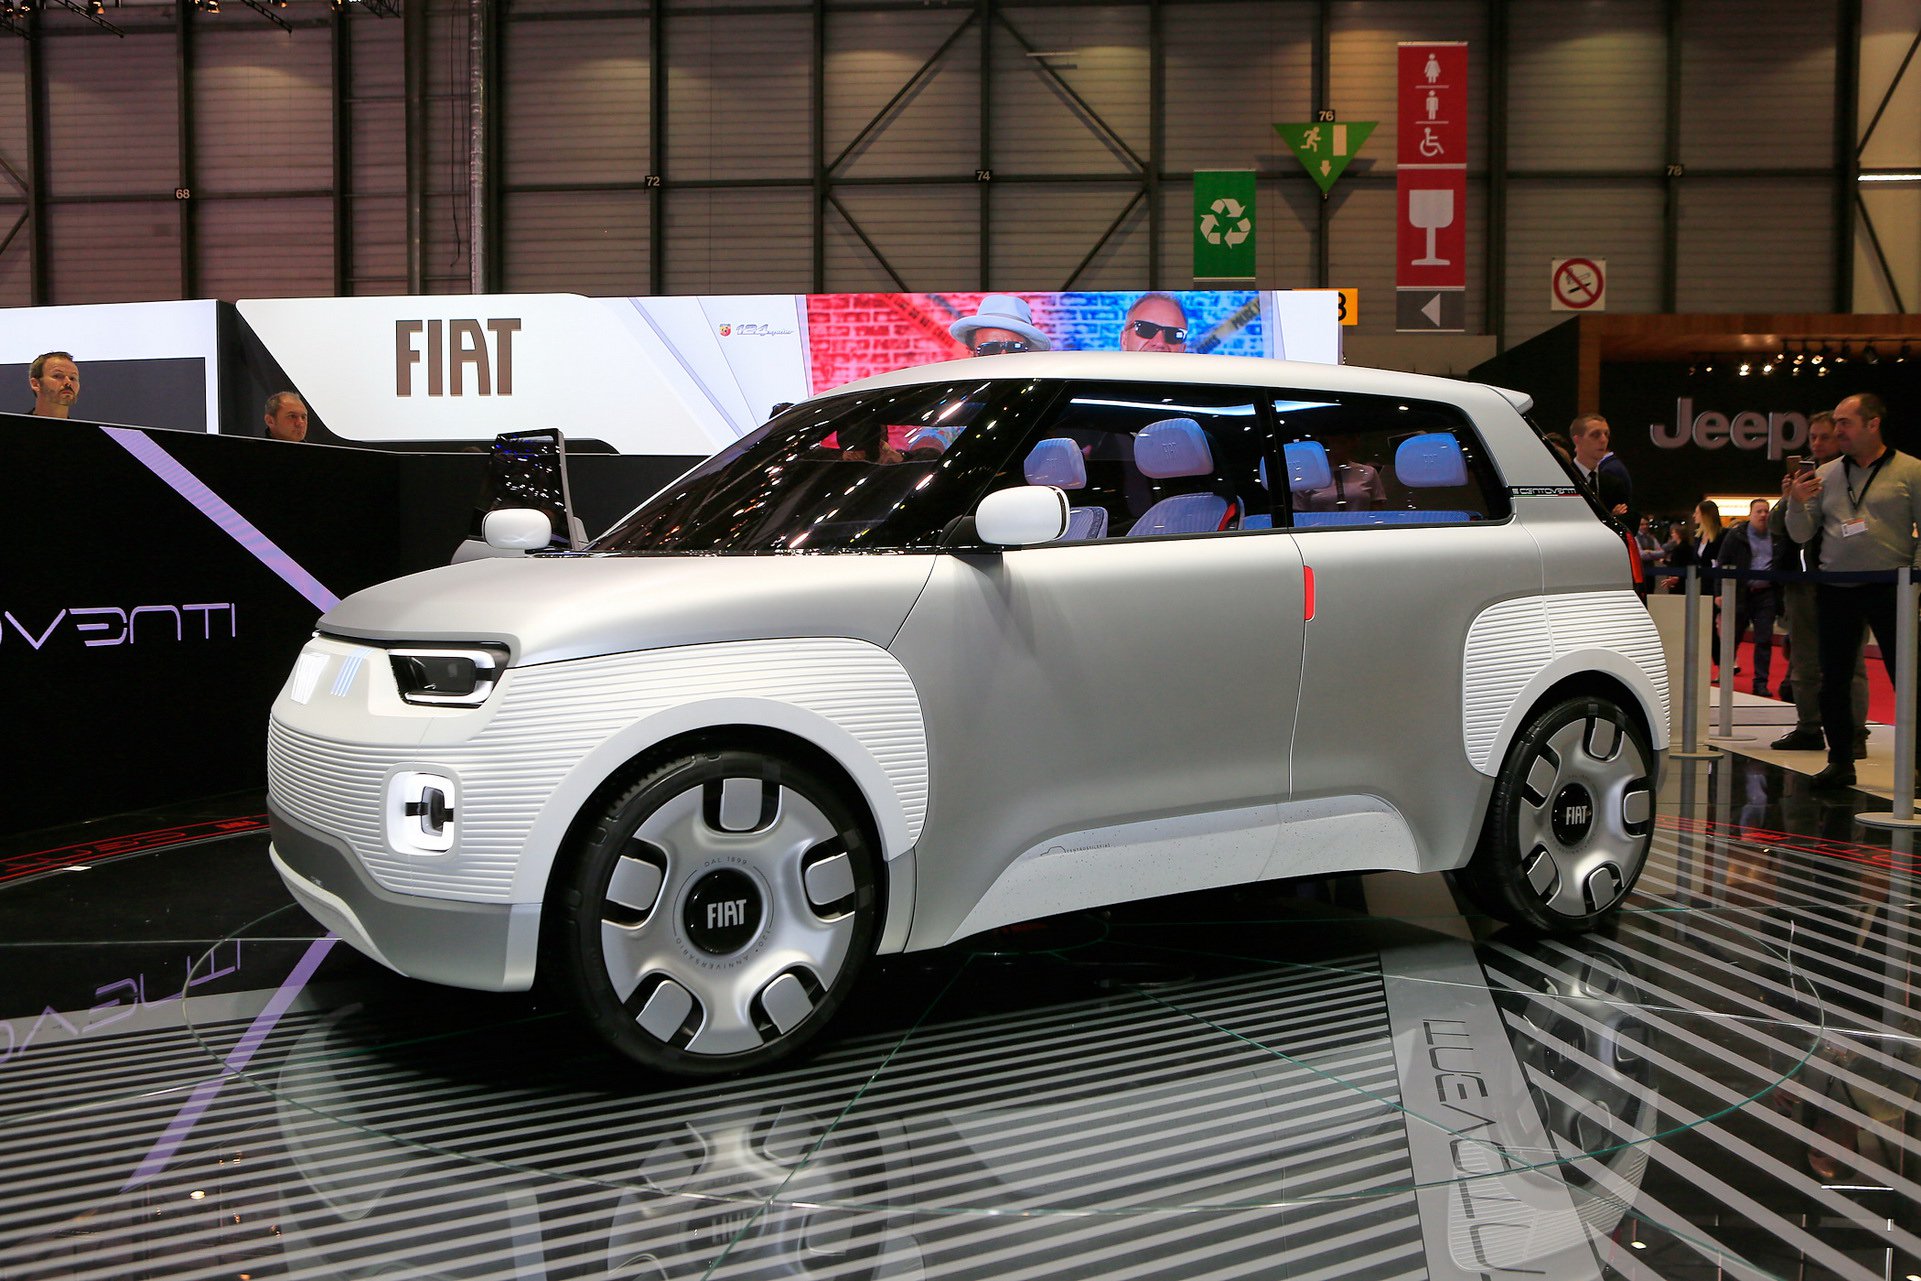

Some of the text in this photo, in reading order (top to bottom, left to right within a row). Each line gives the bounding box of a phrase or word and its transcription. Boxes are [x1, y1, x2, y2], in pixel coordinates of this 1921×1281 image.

[1319, 111, 1334, 122] 76
[976, 170, 991, 181] 74
[1667, 165, 1683, 176] 78
[647, 176, 660, 187] 72
[175, 188, 191, 200] 68
[396, 318, 522, 397] FIAT
[1650, 397, 1809, 461] Jeep
[1565, 805, 1588, 826] FIAT
[704, 859, 722, 868] DAL
[707, 899, 747, 929] FIAT
